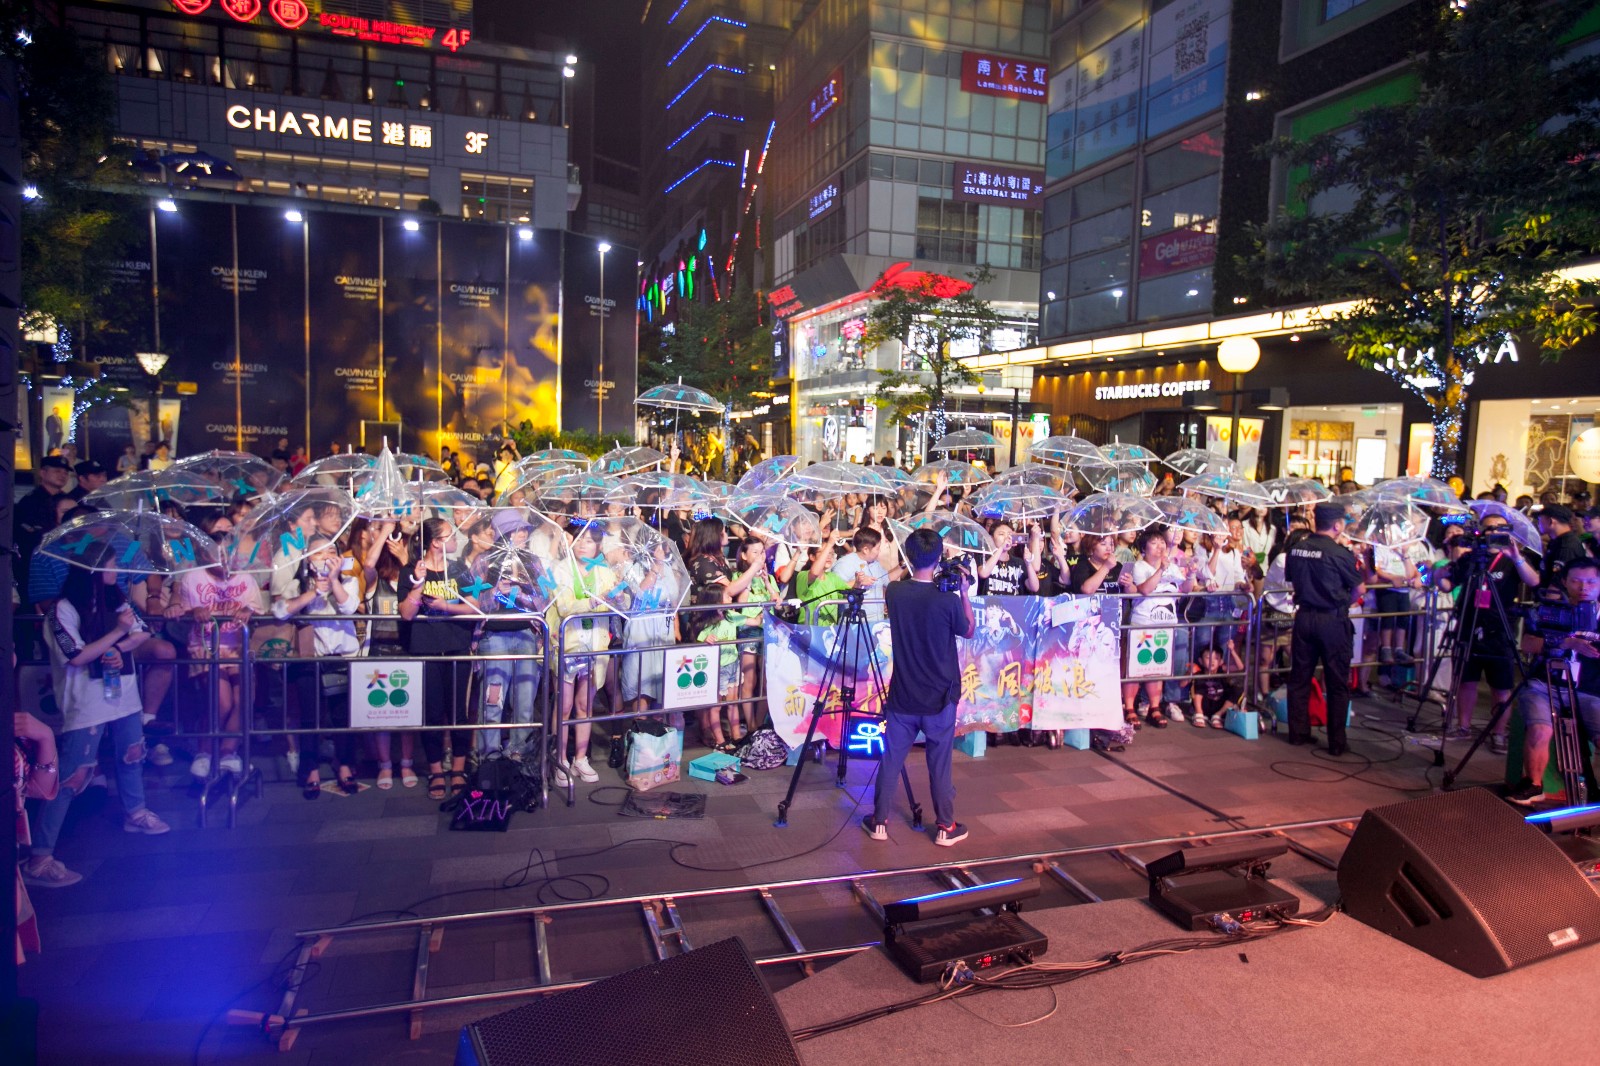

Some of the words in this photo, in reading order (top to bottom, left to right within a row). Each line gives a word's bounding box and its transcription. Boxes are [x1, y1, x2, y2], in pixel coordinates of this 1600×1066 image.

[319, 12, 369, 31] SOUTH
[371, 19, 436, 40] MEMORY
[441, 28, 471, 52] 4F
[226, 104, 373, 142] CHARME
[381, 121, 432, 148] 港丽
[464, 131, 489, 154] 3F
[211, 266, 243, 277] CALVIN
[244, 269, 268, 279] KLEIN
[334, 275, 364, 286] CALVIN
[365, 278, 387, 288] KLEN
[450, 284, 478, 295] CALVIN
[478, 286, 499, 296] KLEIN
[212, 361, 243, 371] CALVIN
[244, 364, 268, 373] KLEIN
[335, 367, 364, 377] CALVIN
[365, 369, 387, 379] KLEN
[450, 373, 476, 382] CALVIN
[1095, 382, 1161, 401] STARBUCKS
[464, 432, 485, 441] KLEIN
[457, 798, 510, 821] XIN
